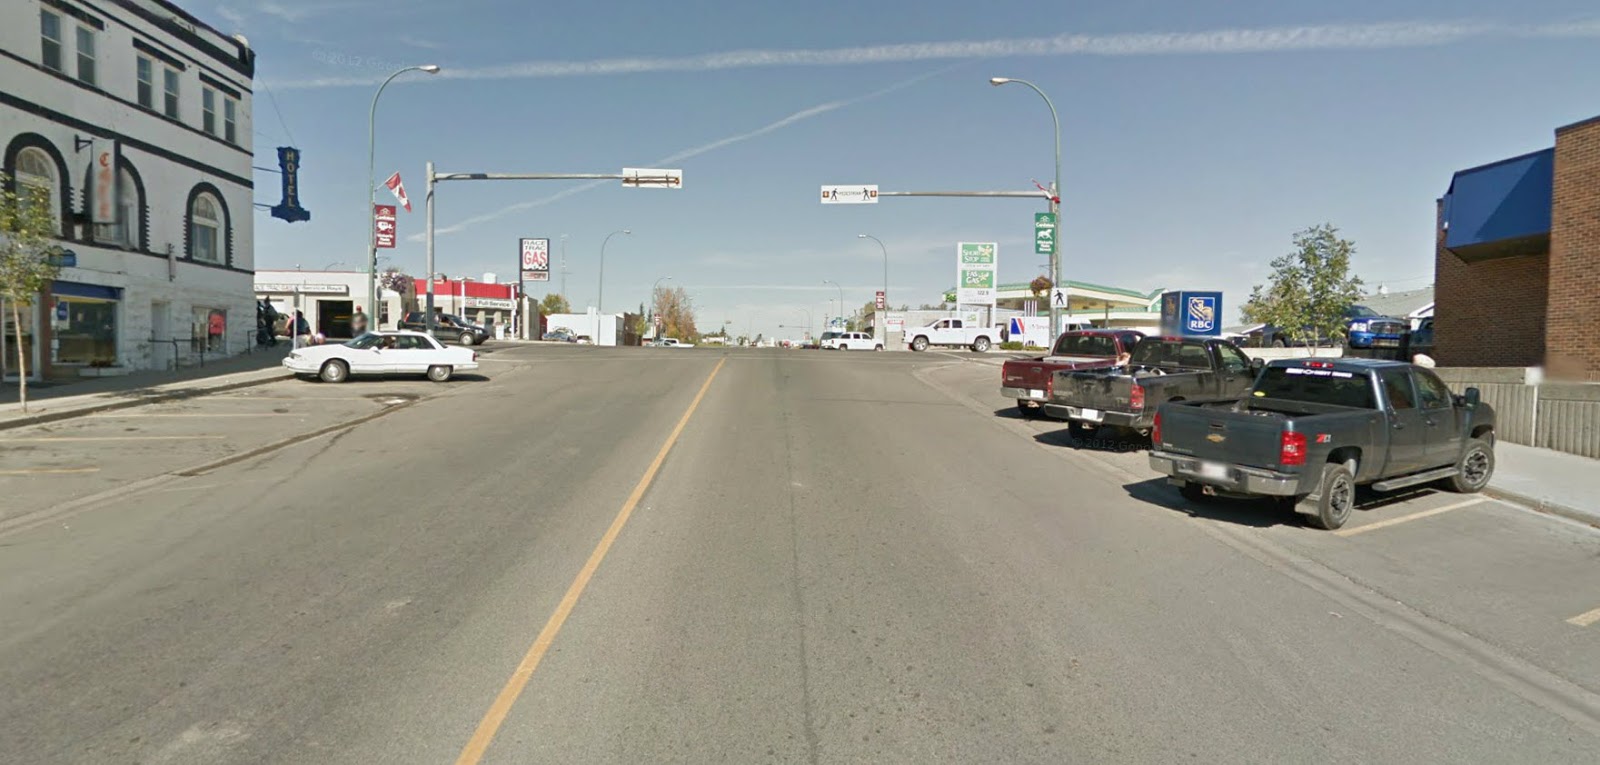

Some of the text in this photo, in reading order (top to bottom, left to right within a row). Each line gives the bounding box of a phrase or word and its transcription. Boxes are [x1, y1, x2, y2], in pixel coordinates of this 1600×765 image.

[287, 151, 295, 208] HOTEL
[524, 251, 547, 265] GAS
[1190, 320, 1212, 329] RBC
